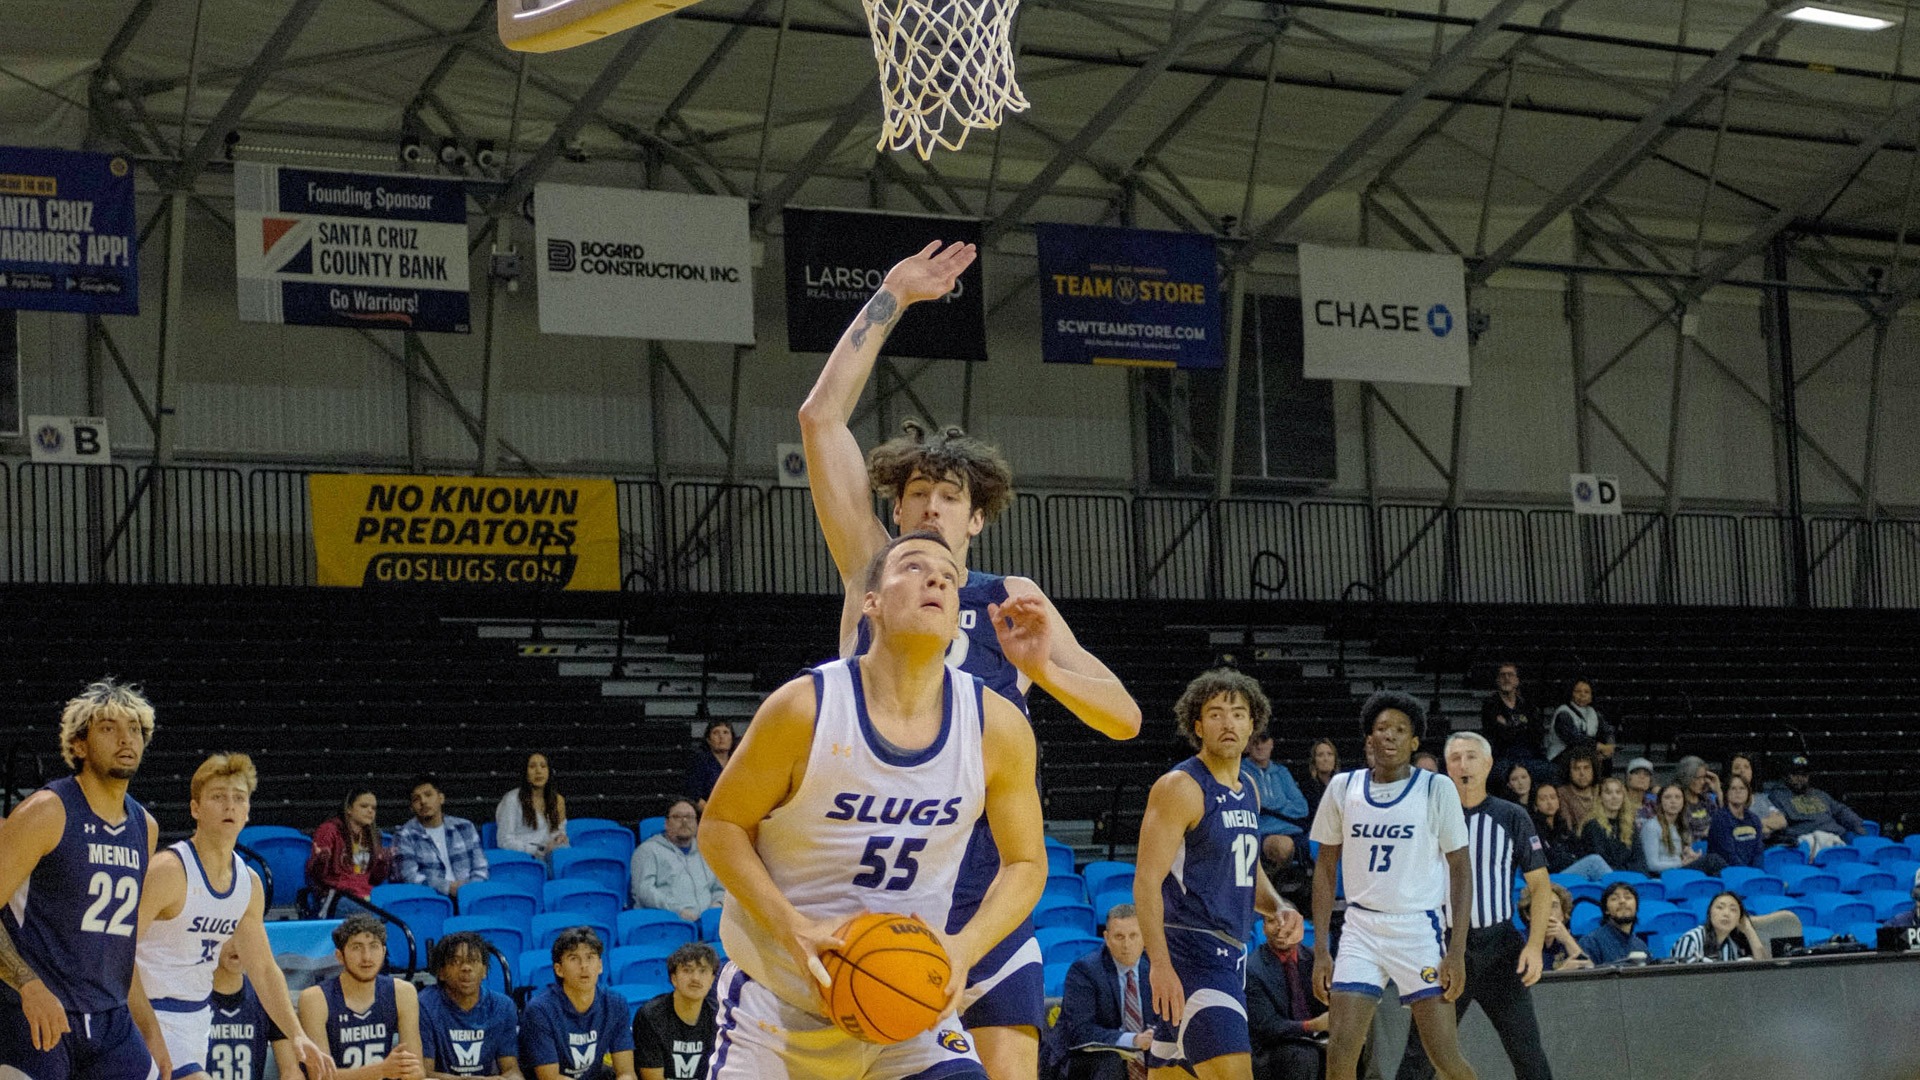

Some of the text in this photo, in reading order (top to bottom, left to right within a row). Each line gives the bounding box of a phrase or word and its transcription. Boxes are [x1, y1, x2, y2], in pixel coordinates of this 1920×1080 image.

[307, 182, 433, 210] Founding Sponsor
[46, 200, 94, 232] CRUZ
[0, 230, 129, 267] ARRIORS APP!
[319, 222, 418, 250] SANTA CRUZ
[580, 241, 645, 260] BOGARD
[320, 250, 448, 281] COUNTY BANK
[580, 258, 708, 283] CONSTRUCTION,
[805, 264, 888, 290] LARSO
[329, 289, 419, 313] Go Warriors!
[1052, 274, 1113, 298] TEAM
[1138, 280, 1206, 305] STORE
[1056, 319, 1207, 341] SCWTEAMSTORE.COM
[1314, 300, 1420, 332] CHASE
[74, 426, 101, 455] B
[365, 484, 579, 515] NO KNOWN
[1598, 480, 1616, 505] D
[354, 516, 578, 546] PREDATORS
[375, 557, 562, 583] GOSLUGS.COM
[825, 792, 962, 826] SLUGS
[1351, 823, 1415, 839] SLUGS
[87, 843, 140, 870] MENLO
[852, 836, 928, 891] 55
[1231, 833, 1259, 887] 12
[1368, 844, 1395, 873] 13
[80, 871, 139, 937] 22
[210, 1024, 254, 1040] MENLO
[340, 1023, 386, 1043] MENLO
[449, 1029, 484, 1041] MENLO
[569, 1030, 598, 1045] MENLO
[673, 1040, 703, 1053] MENLO
[211, 1044, 252, 1080] 33
